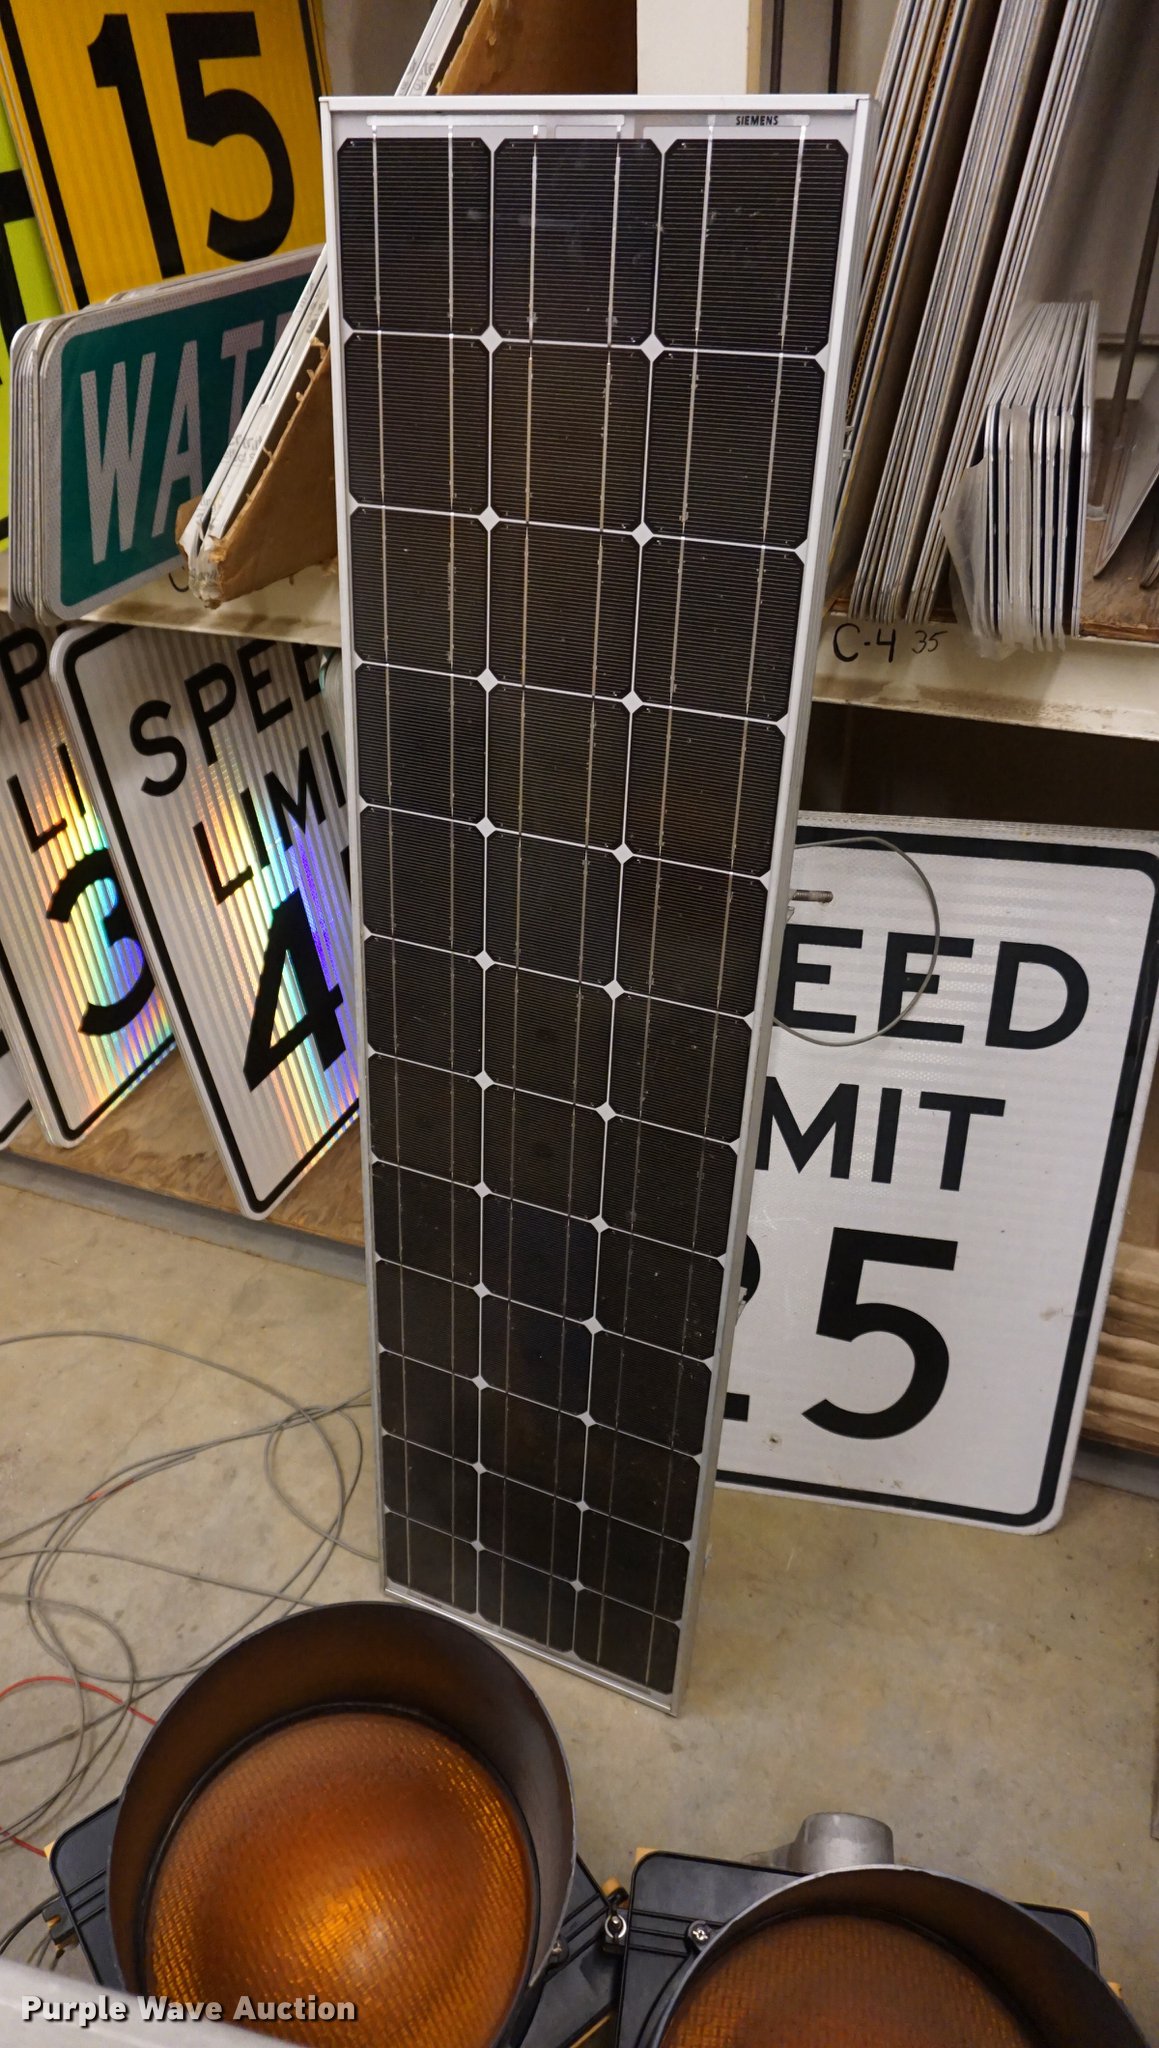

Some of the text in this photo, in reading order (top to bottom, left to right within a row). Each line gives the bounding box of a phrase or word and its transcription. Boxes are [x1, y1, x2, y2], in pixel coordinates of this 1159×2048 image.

[87, 11, 295, 279] 15
[736, 115, 779, 126] SIEMENS
[80, 311, 294, 565] WAT
[833, 623, 949, 663] C-4 35
[773, 923, 1089, 1050] EED
[754, 1075, 1007, 1192] MIT
[722, 1226, 959, 1440] 5
